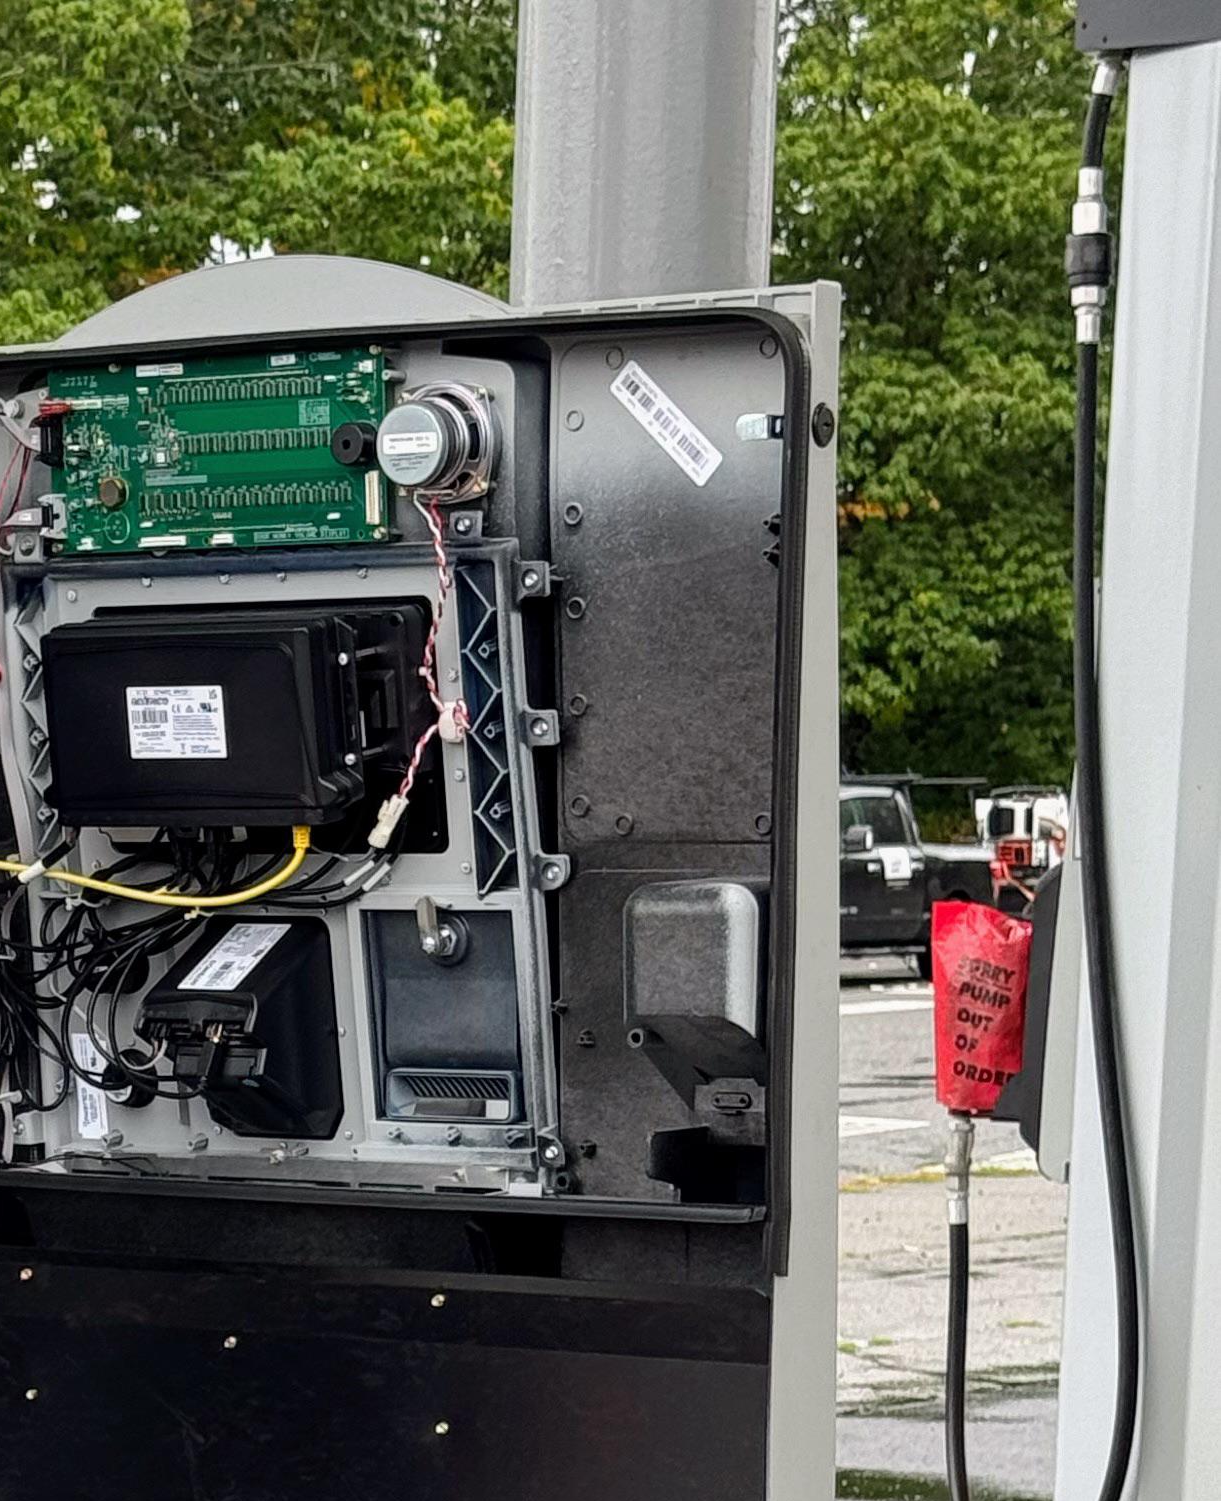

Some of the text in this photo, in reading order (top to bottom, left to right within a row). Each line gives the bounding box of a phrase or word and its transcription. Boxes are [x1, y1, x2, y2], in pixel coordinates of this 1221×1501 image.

[958, 981, 1011, 1010] PUMP
[957, 1008, 994, 1033] OUT
[954, 1033, 979, 1052] OF
